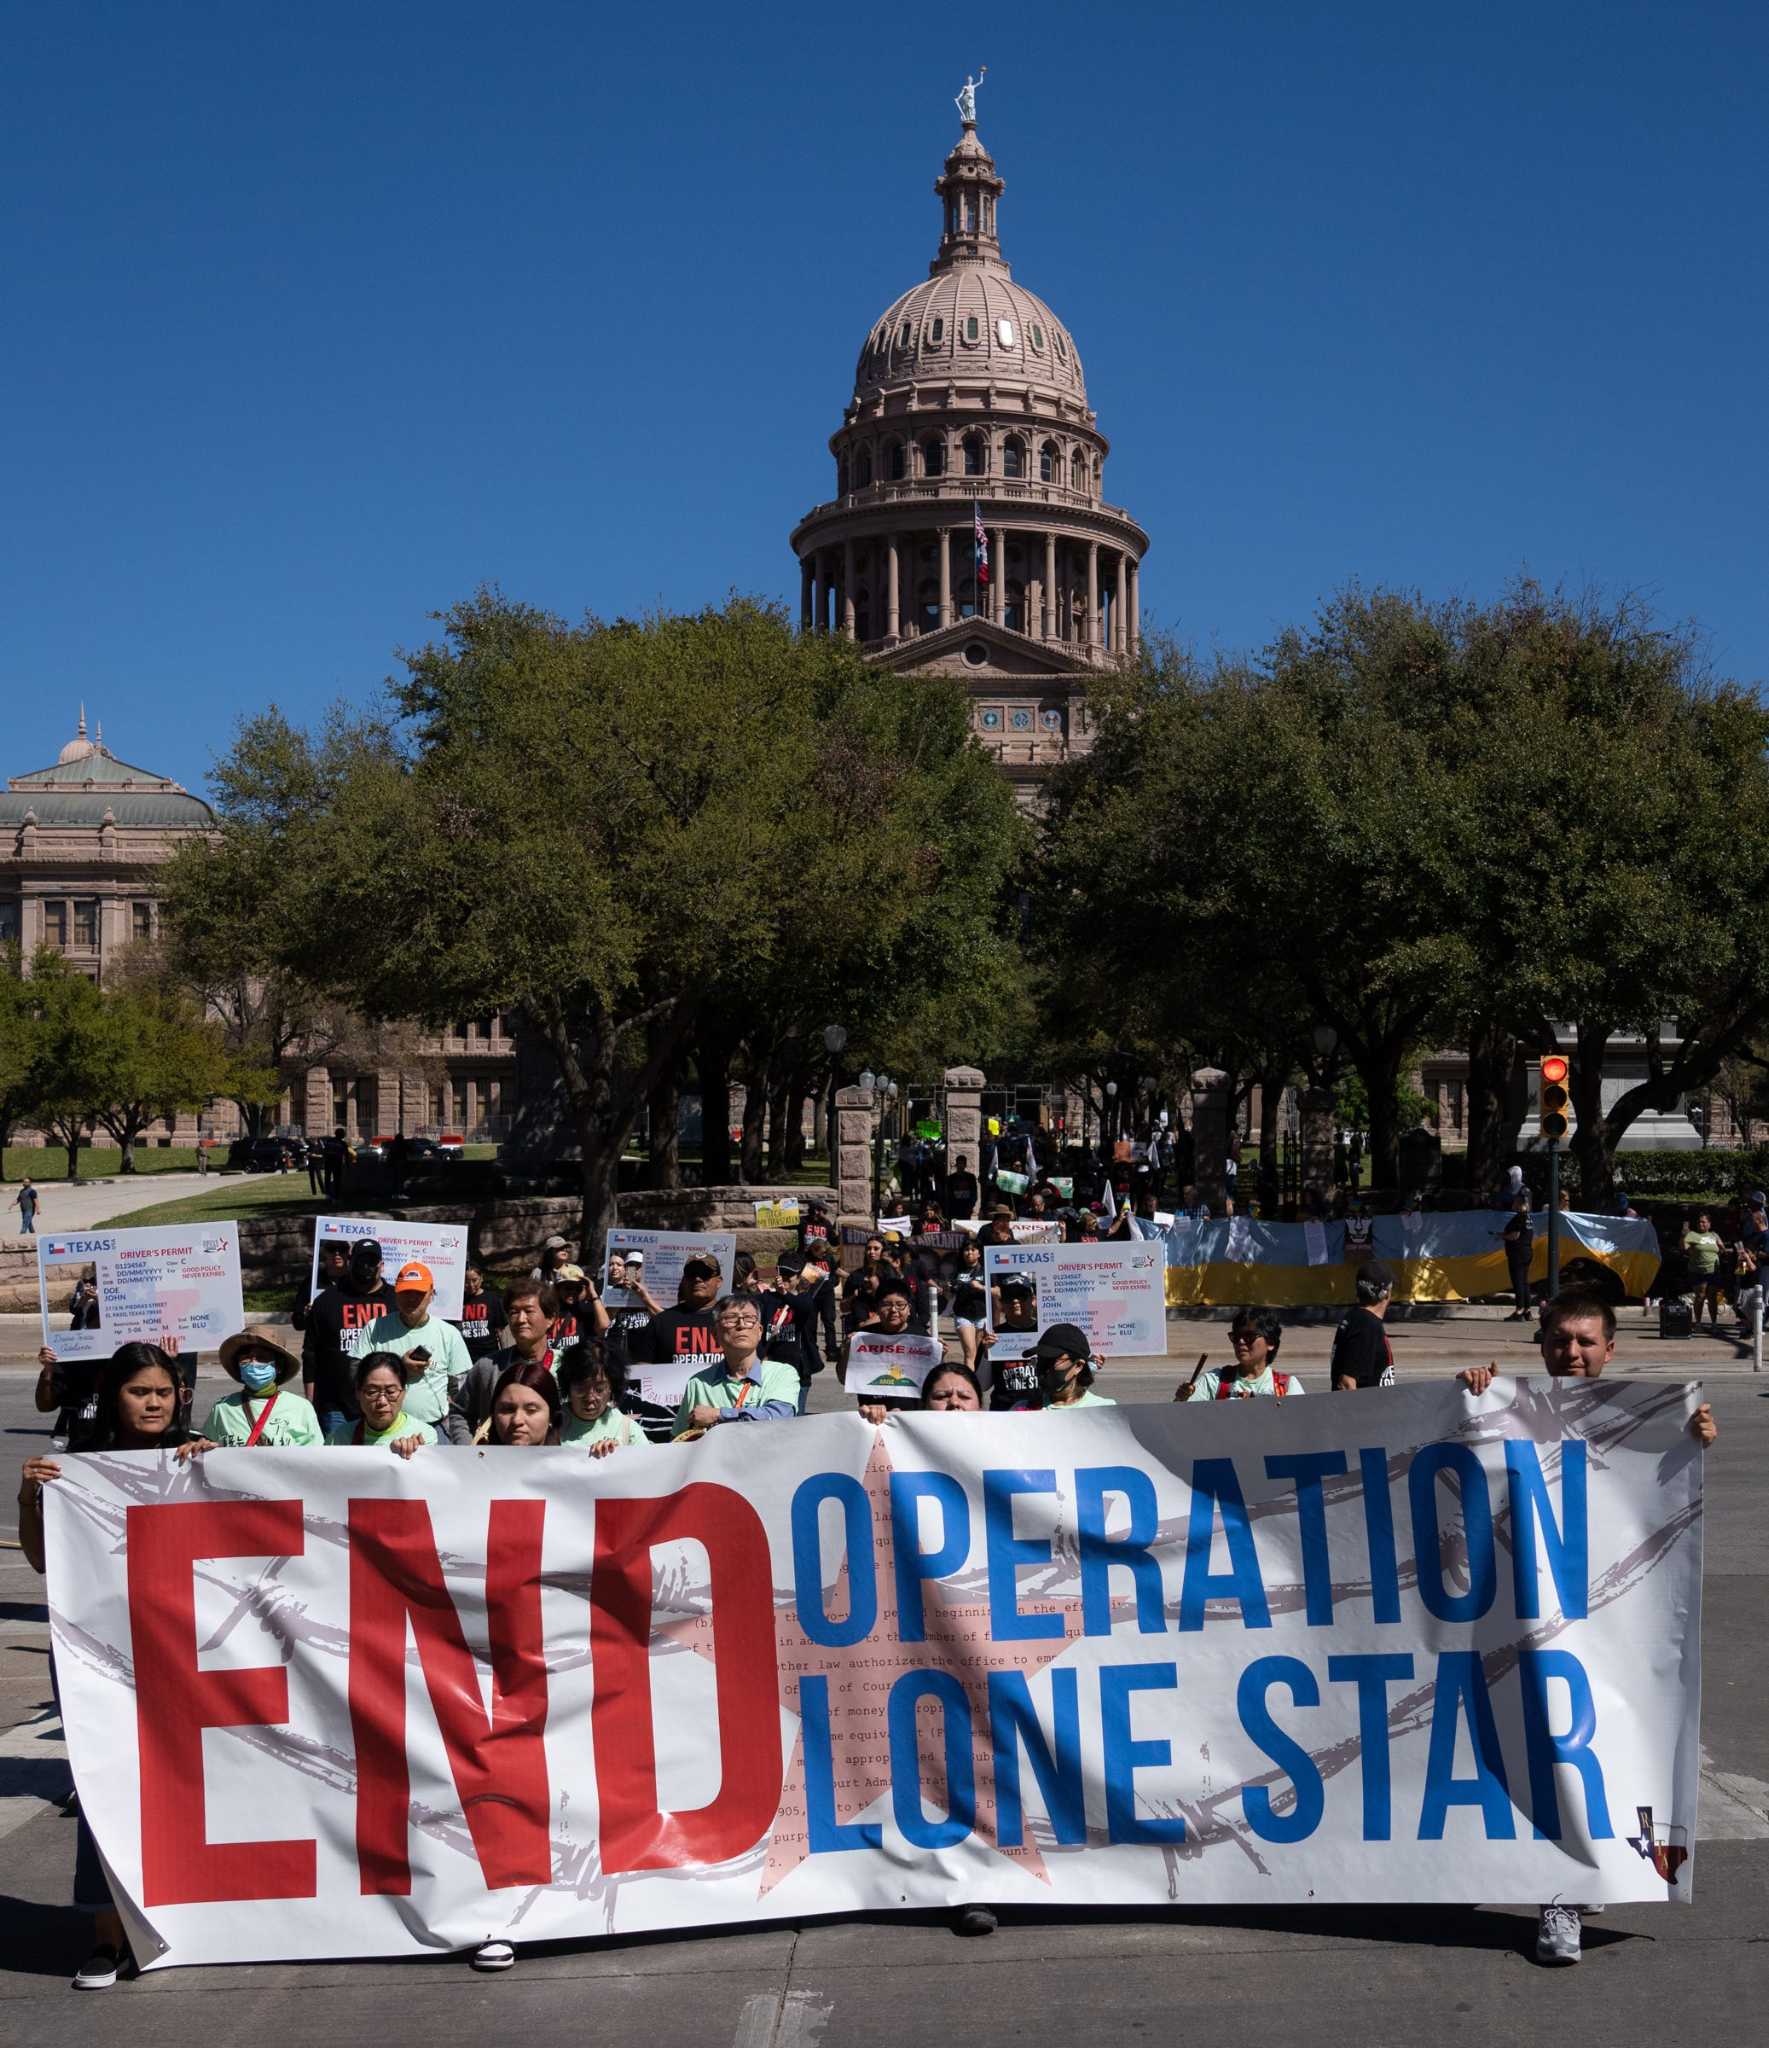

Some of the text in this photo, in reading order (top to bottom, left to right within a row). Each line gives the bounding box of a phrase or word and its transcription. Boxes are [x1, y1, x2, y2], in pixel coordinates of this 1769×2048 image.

[339, 1225, 371, 1235] TEXAS
[806, 1224, 827, 1237] END
[67, 1239, 110, 1253] TEXAS
[120, 1247, 193, 1259] DRIVER'S PERMIT
[1012, 1253, 1049, 1263] TEXAS
[1058, 1262, 1123, 1271] DRIVER'S PERMIT
[104, 1287, 120, 1295] DOE
[105, 1294, 126, 1302] JOHN
[465, 1304, 487, 1320] ND
[857, 1344, 905, 1354] ARISE
[1003, 1365, 1036, 1380] OPERAT
[791, 1439, 1588, 1648] OPERATION
[1033, 1602, 1056, 1613] the
[818, 1659, 840, 1669] law
[849, 1655, 928, 1669] authorizes
[932, 1654, 953, 1665] the
[960, 1652, 1004, 1666] office
[1014, 1653, 1028, 1664] to
[839, 1682, 852, 1693] of
[126, 1481, 783, 1907] END
[848, 1706, 885, 1718] money
[800, 1649, 1616, 1855] LONE STAR
